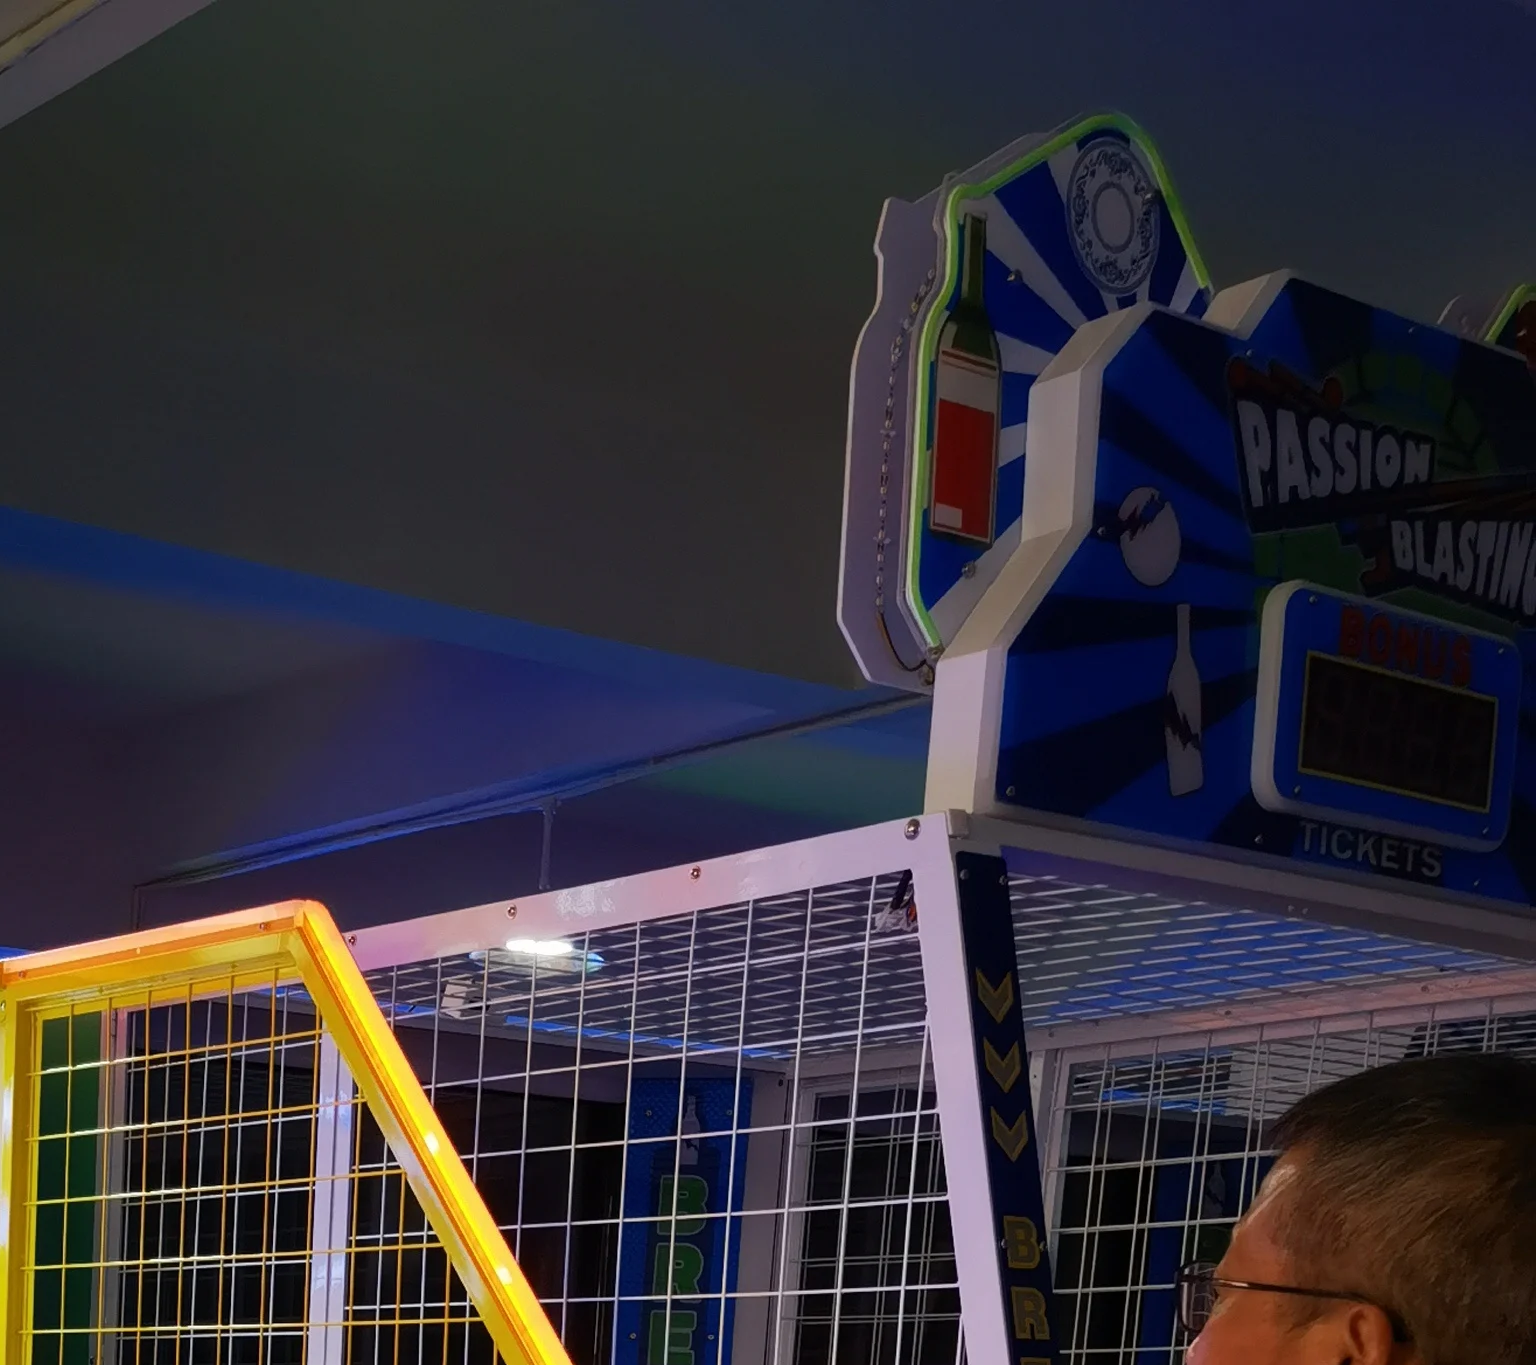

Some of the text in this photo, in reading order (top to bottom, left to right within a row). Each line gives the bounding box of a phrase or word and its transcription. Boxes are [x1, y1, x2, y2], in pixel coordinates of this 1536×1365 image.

[1235, 399, 1434, 509] PASSION
[1338, 604, 1472, 688] BONUS
[1300, 818, 1443, 880] TICKETS
